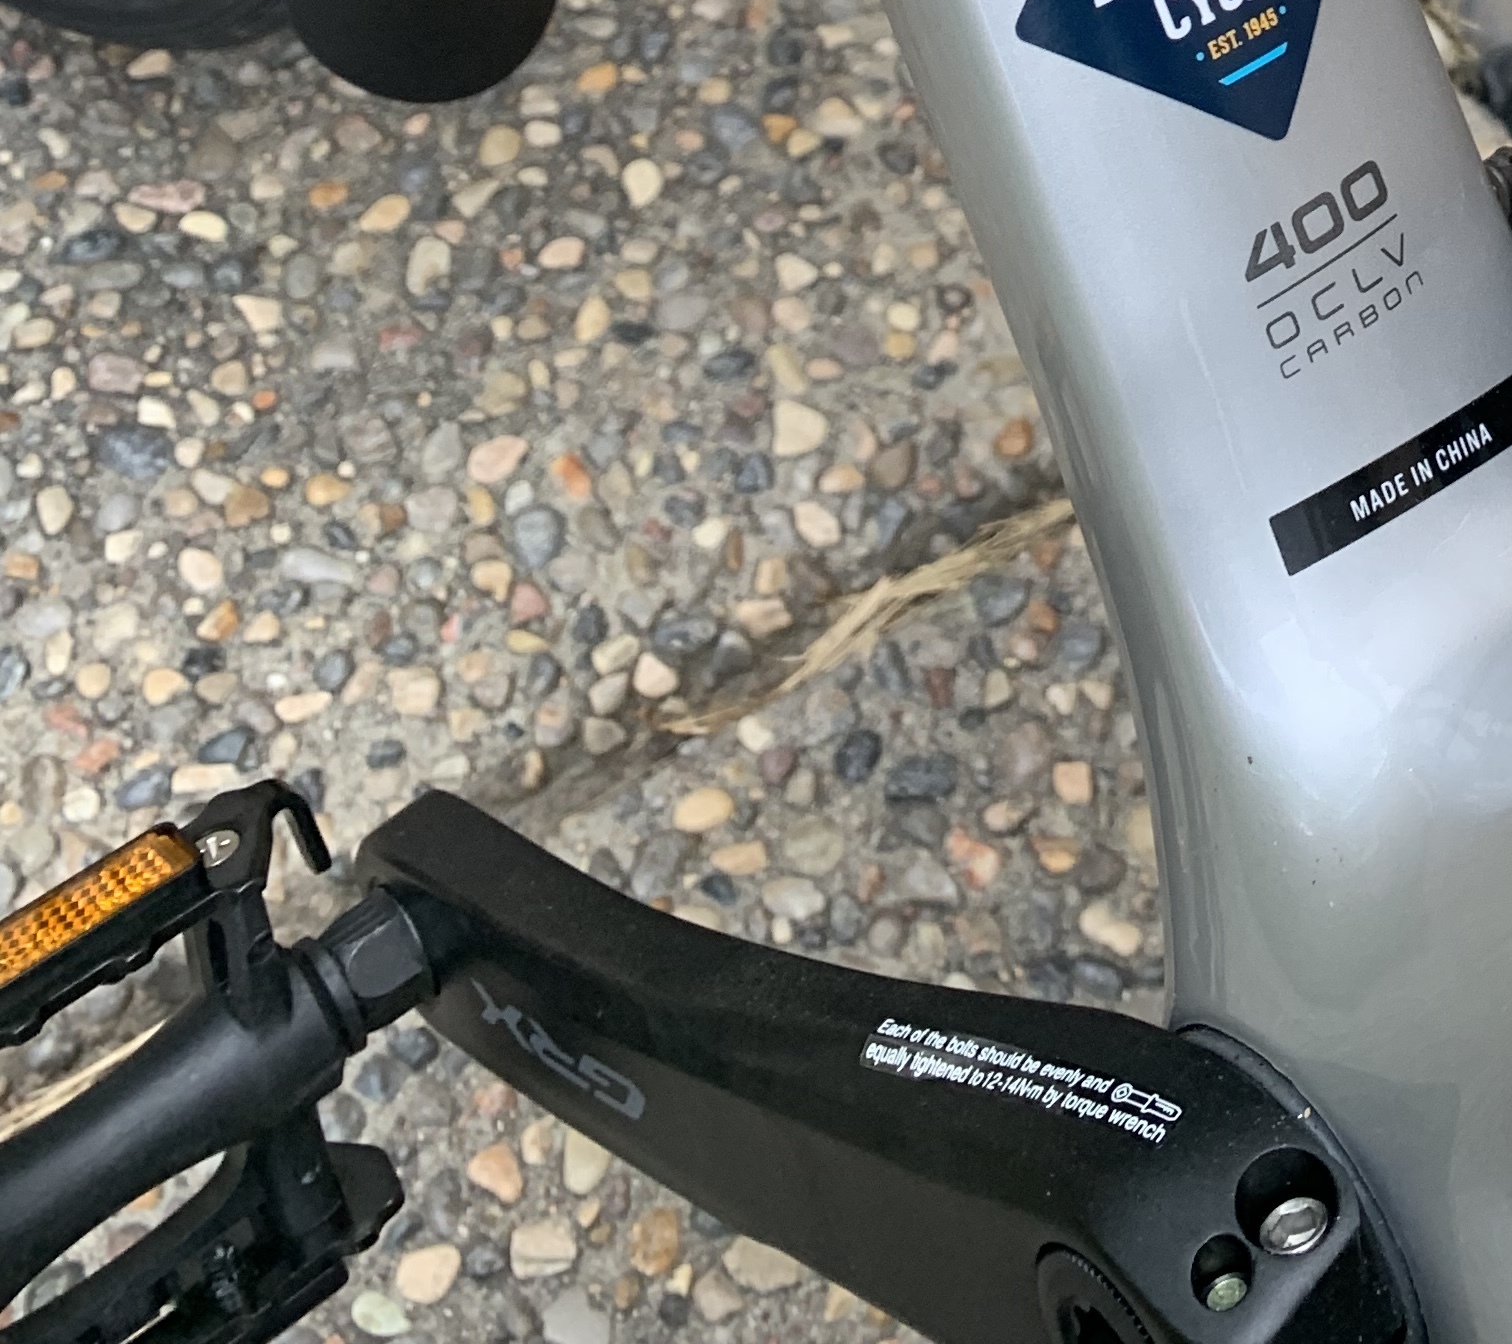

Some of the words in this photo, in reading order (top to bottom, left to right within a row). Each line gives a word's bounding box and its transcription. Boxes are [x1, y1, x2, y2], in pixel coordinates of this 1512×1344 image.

[1207, 28, 1244, 61] EST.
[1242, 10, 1280, 41] 1945
[1244, 160, 1389, 282] 400
[1265, 232, 1405, 349] OCLV
[1350, 472, 1409, 522] MADE
[1411, 461, 1434, 487] IN
[1435, 422, 1493, 472] CHINA
[865, 1042, 912, 1072] equally
[909, 1051, 973, 1084] tightened
[1042, 1084, 1063, 1109] by
[1060, 1091, 1109, 1118] torque
[1107, 1108, 1166, 1144] wrench
[877, 1018, 912, 1038] Each
[910, 1028, 930, 1043] of
[924, 1030, 948, 1049] the
[945, 1035, 979, 1059] bolts
[977, 1045, 1027, 1070] should
[1020, 1055, 1042, 1073] be
[1039, 1063, 1085, 1088] evenly
[1081, 1075, 1115, 1094] and
